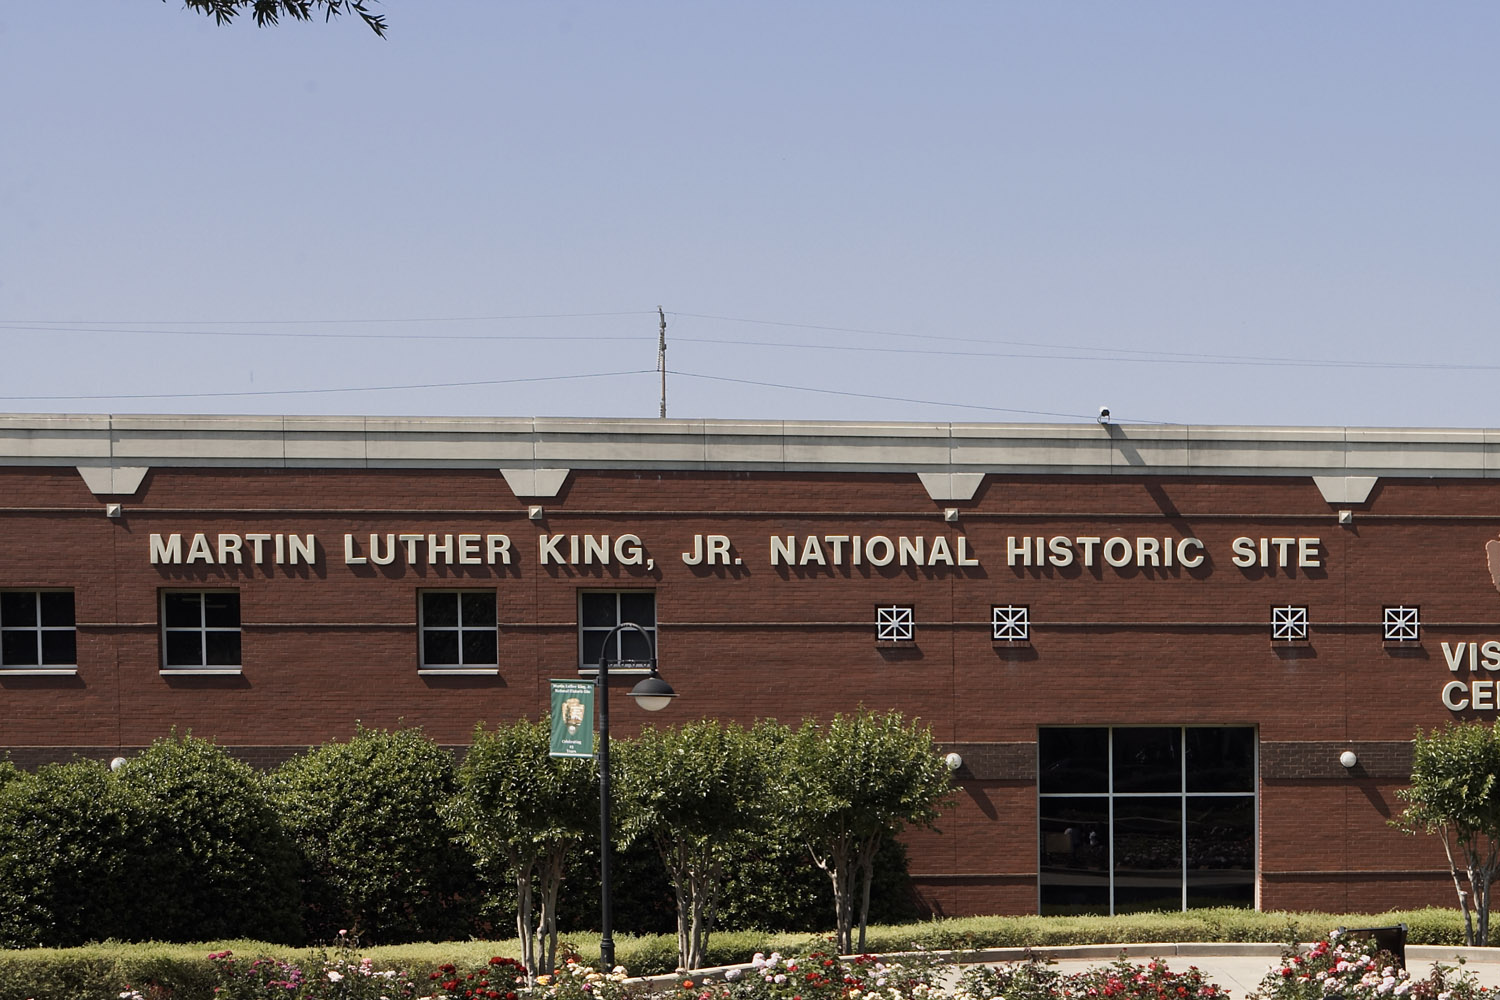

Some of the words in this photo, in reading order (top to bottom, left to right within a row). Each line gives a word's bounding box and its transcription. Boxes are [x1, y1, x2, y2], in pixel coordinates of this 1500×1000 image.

[149, 533, 315, 565] MARTIN
[344, 533, 511, 565] LUTHER
[539, 533, 654, 570] KING,
[682, 534, 742, 566] JR.
[770, 535, 979, 567] NATIONAL
[1007, 535, 1205, 568] HISTORIC
[1231, 536, 1321, 568] SITE
